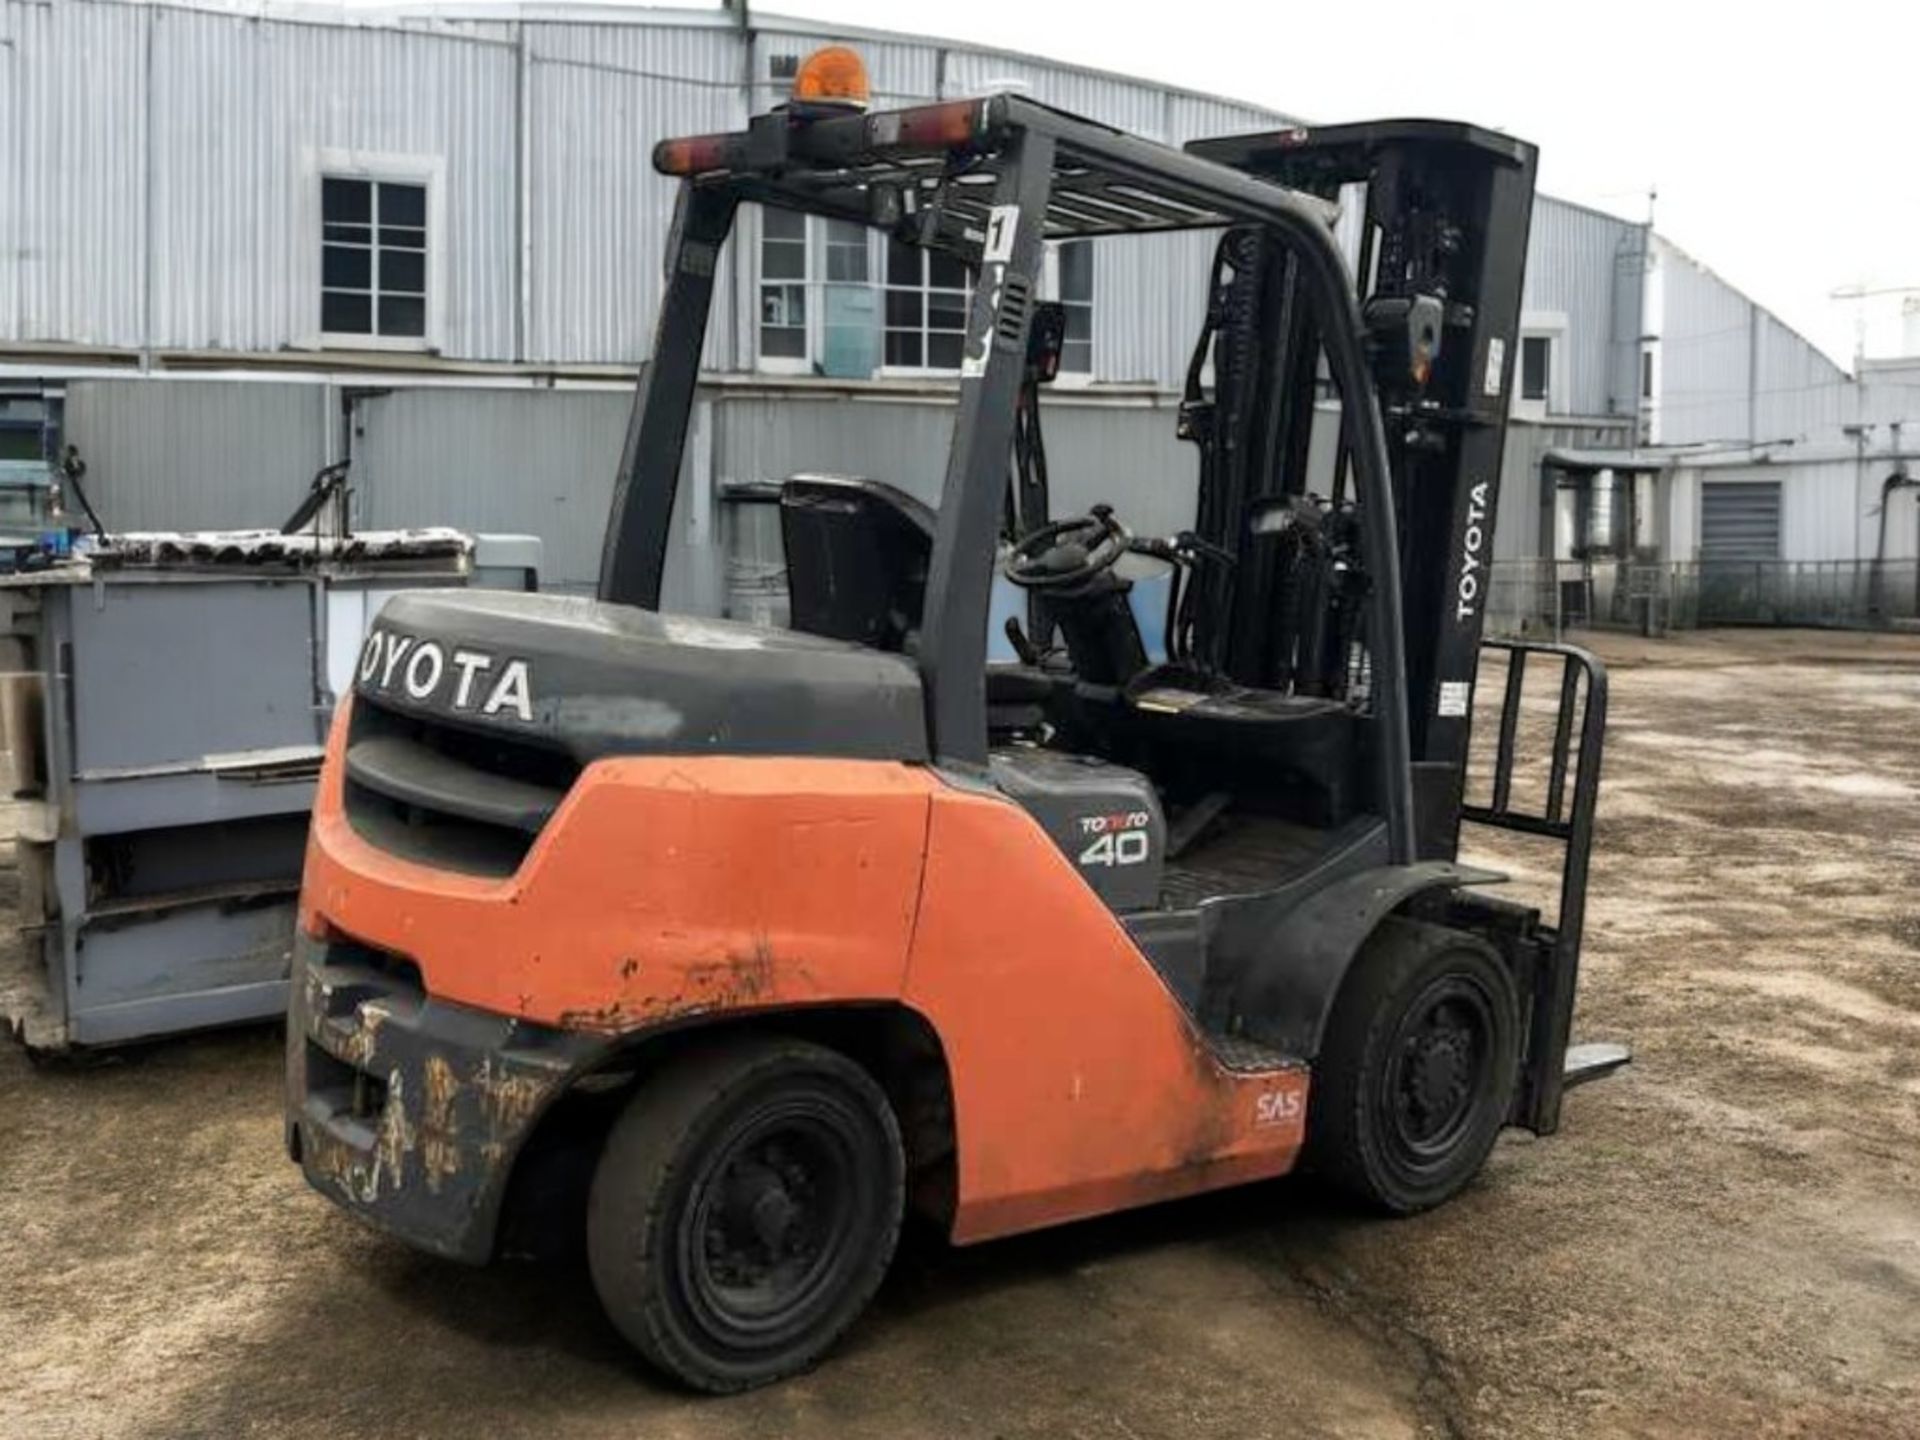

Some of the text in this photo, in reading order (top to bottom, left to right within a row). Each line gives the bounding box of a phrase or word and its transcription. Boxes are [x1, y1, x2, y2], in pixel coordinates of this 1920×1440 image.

[1456, 481, 1489, 622] TOYOTA
[361, 630, 533, 721] OYOTA
[1080, 830, 1148, 867] 40
[1257, 1090, 1301, 1120] SAS
